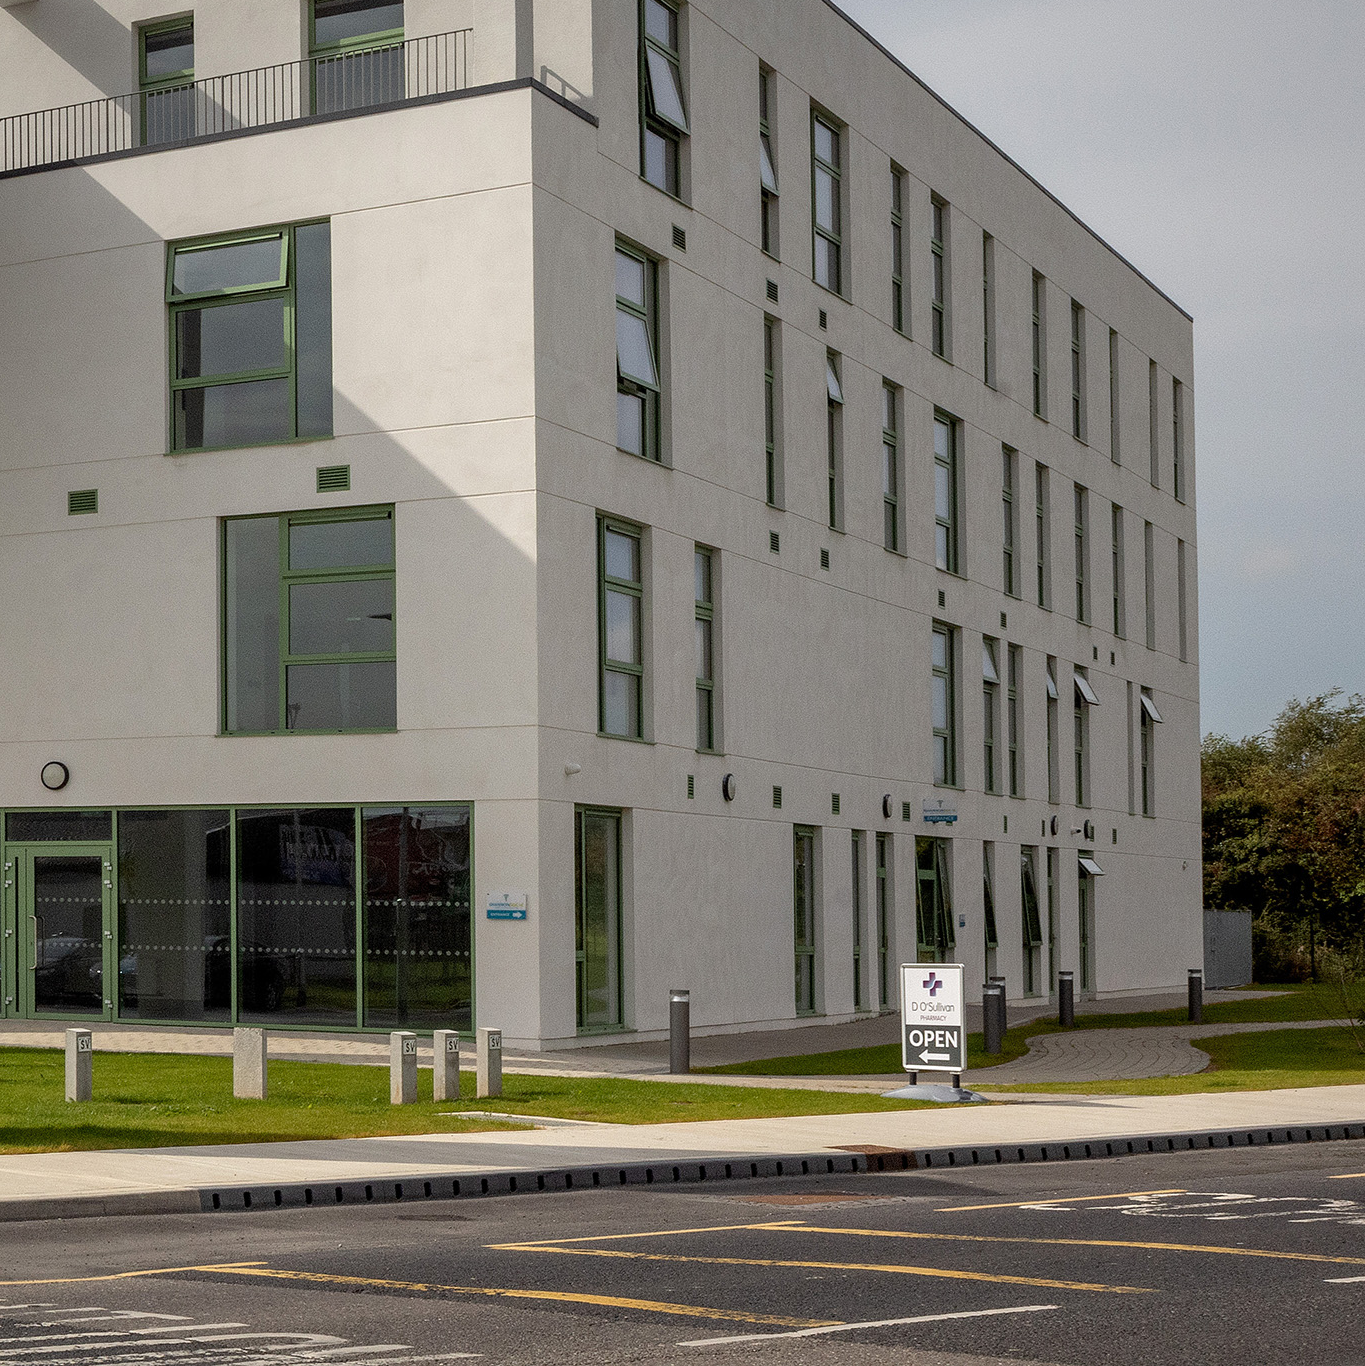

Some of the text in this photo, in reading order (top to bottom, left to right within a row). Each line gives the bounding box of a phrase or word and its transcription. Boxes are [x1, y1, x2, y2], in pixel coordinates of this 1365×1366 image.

[912, 1002, 954, 1012] D O'Sullivan
[909, 1030, 957, 1047] OPEN
[80, 1039, 90, 1050] SV
